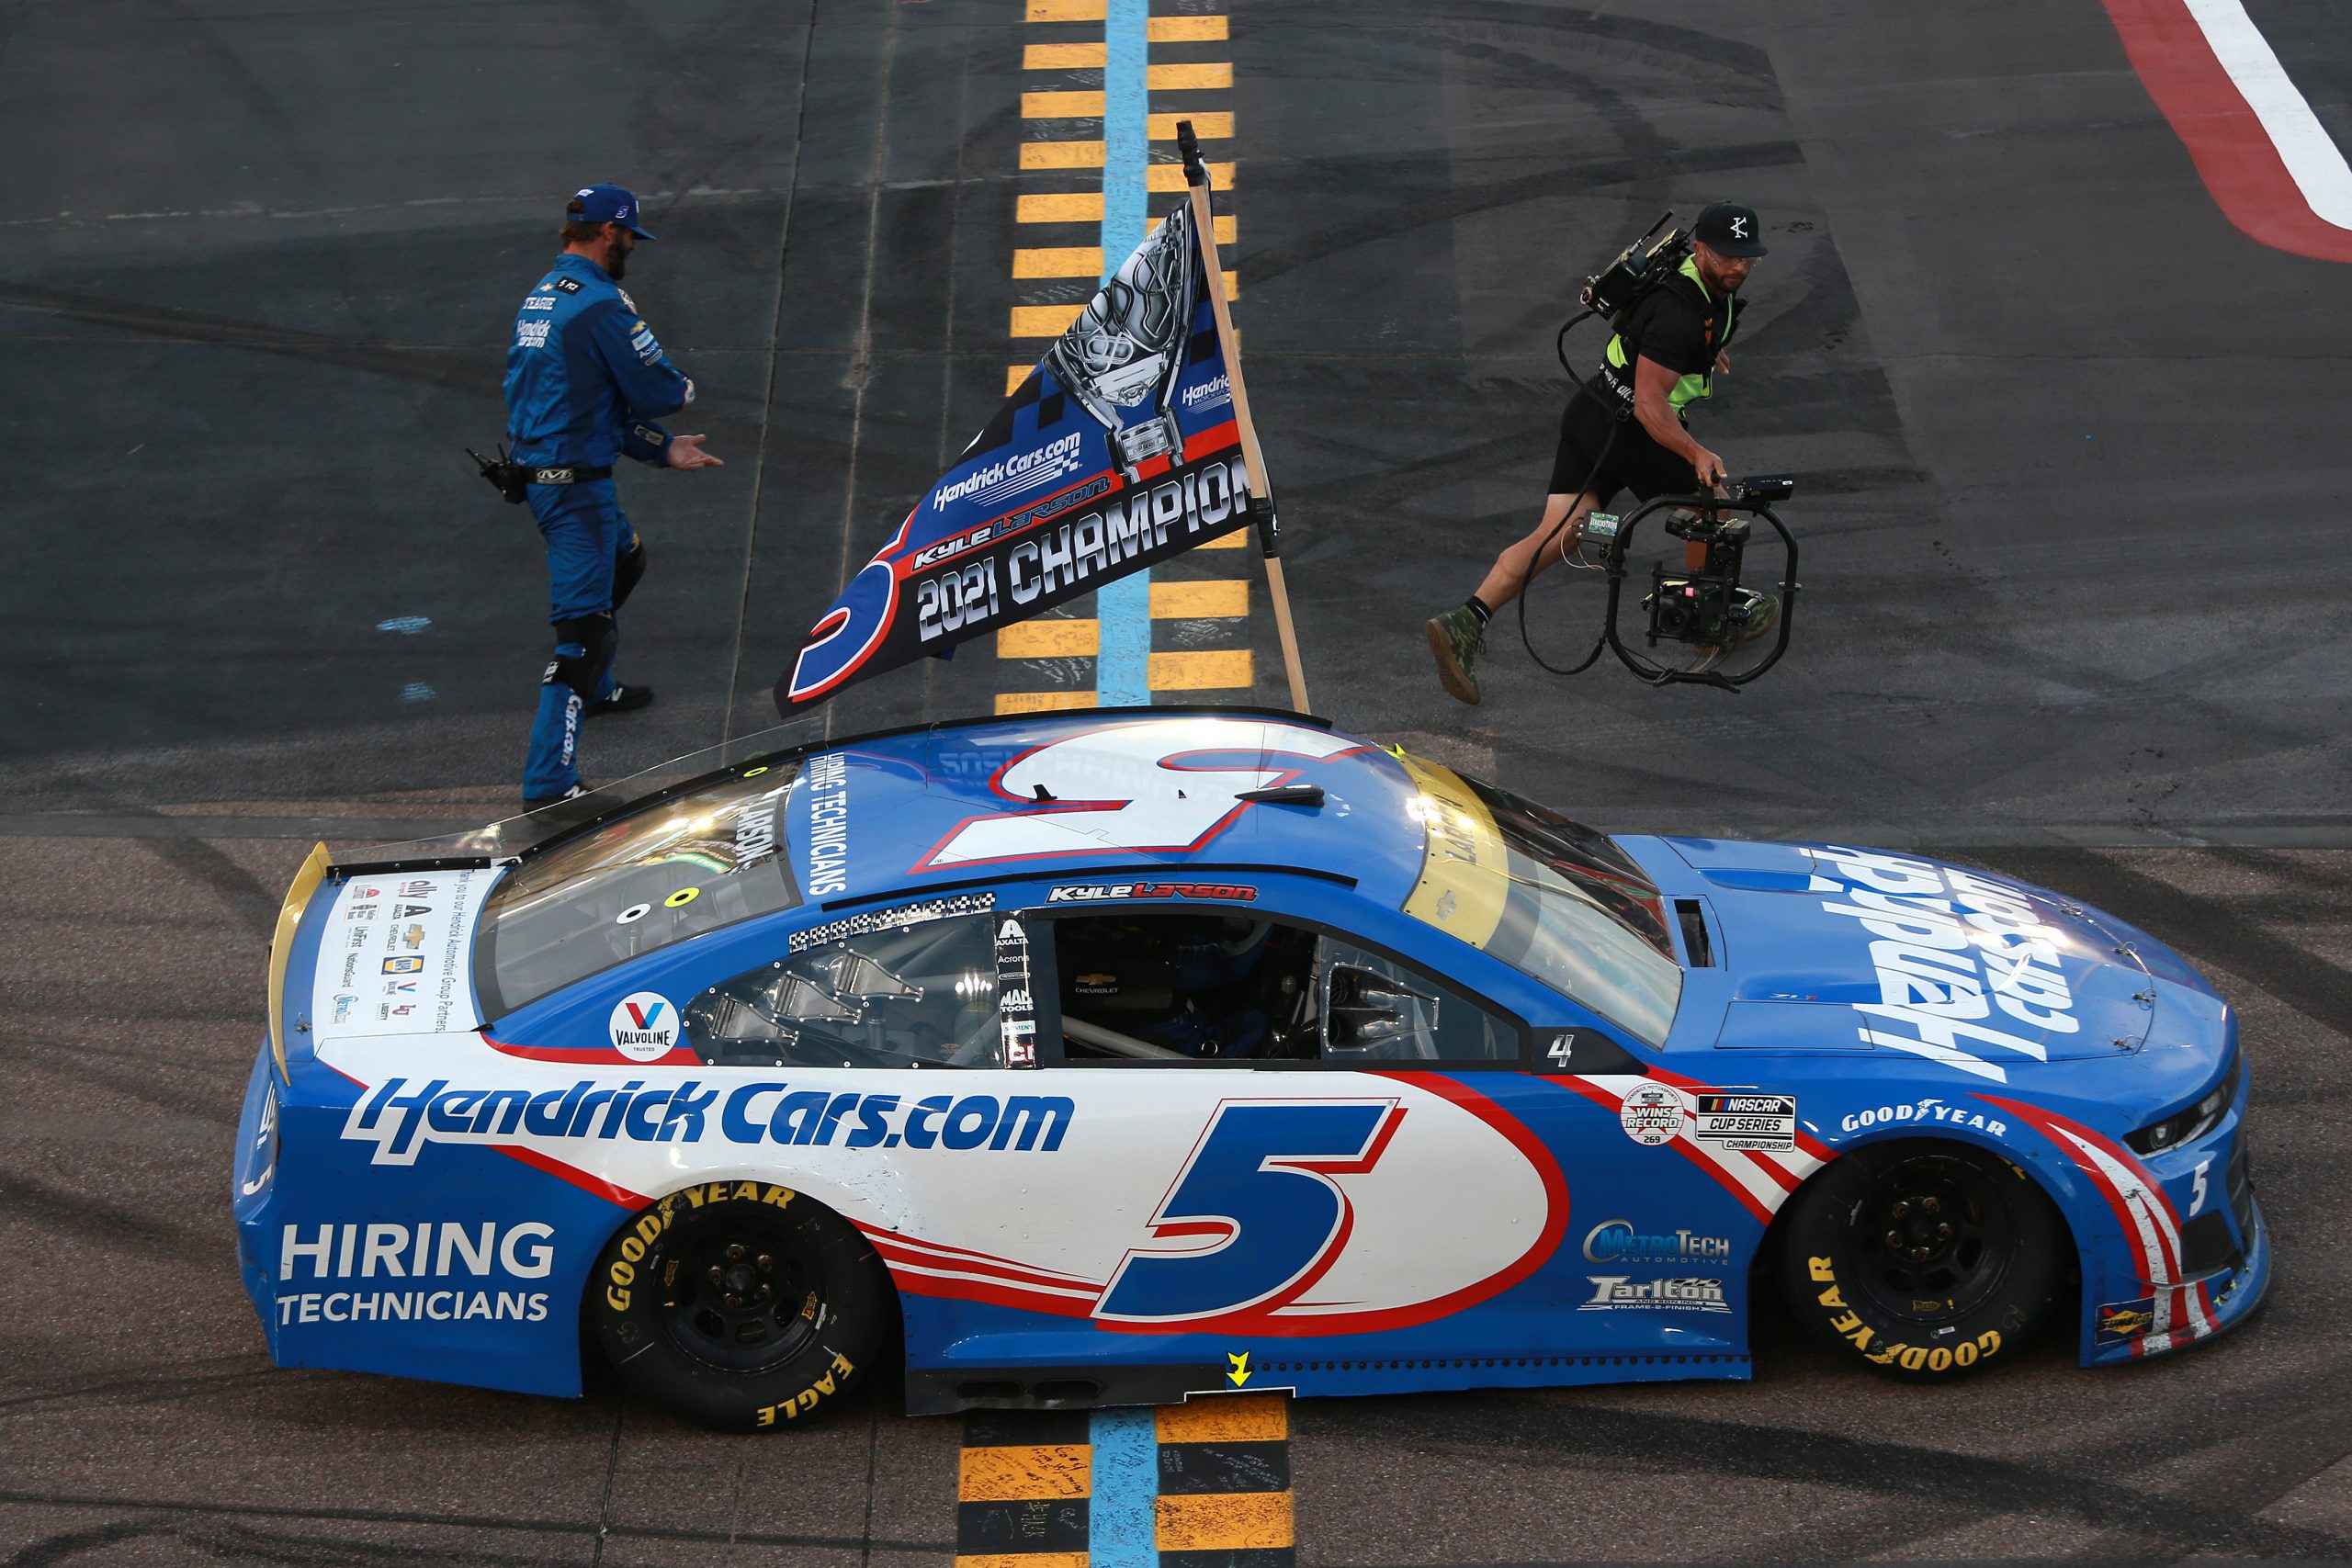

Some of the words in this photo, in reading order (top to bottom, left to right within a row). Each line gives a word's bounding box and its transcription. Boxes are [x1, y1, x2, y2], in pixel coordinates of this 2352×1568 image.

[1182, 374, 1230, 406] Hendric
[918, 556, 1000, 642] 2021
[808, 752, 847, 792] HIRING
[808, 790, 847, 896] TECHNICIANS
[398, 880, 437, 899] ally
[455, 883, 469, 894] you
[454, 901, 464, 911] our
[449, 911, 467, 938] Hendrick
[350, 926, 369, 948] UniFirst
[386, 924, 399, 952] CHEVROLET
[442, 939, 462, 976] Automotive
[342, 953, 359, 988] NationsGuard
[436, 977, 457, 999] Group
[379, 1003, 390, 1021] LIBERTY
[616, 1029, 670, 1046] VALVOLINE
[1635, 1107, 1672, 1119] WINS
[1727, 1099, 1781, 1112] NASCAR
[1625, 1118, 1679, 1129] RECORD
[1710, 1118, 1735, 1131] CUP
[1736, 1118, 1781, 1131] SERIES
[1644, 1135, 1661, 1145] 269
[1725, 1140, 1792, 1150] CHAMPIONSHIP
[2189, 1159, 2210, 1217] 5
[1090, 1098, 1409, 1325] 5
[279, 1221, 555, 1281] HIRING
[1621, 1257, 1728, 1266] AUTOMOTIVE
[1587, 1276, 1724, 1303] Tarlton
[277, 1291, 549, 1325] TECHNICIANS
[756, 1353, 854, 1427] EAGLE
